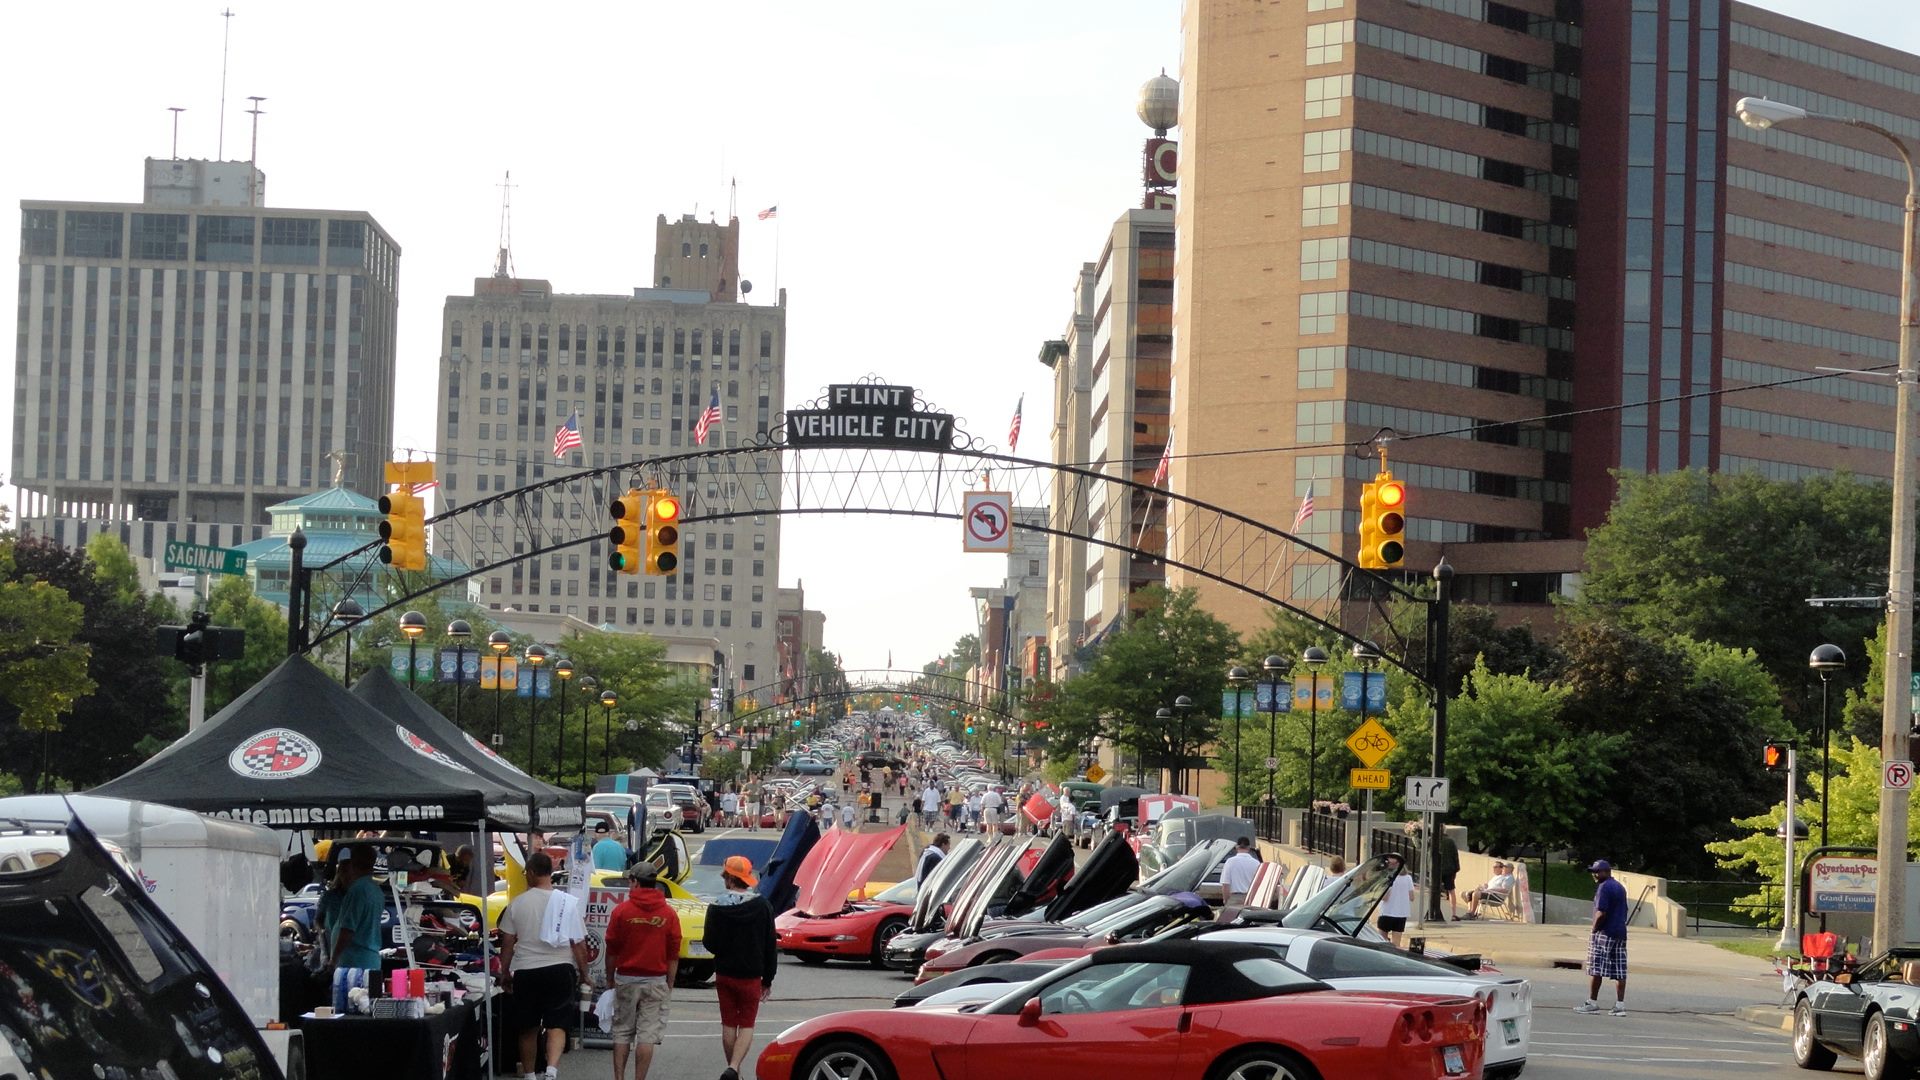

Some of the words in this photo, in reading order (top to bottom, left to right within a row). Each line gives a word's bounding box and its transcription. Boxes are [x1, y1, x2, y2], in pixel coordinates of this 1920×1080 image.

[835, 387, 904, 406] FLINT
[793, 415, 885, 437] VEHICLE
[894, 416, 946, 441] CITY
[167, 543, 226, 570] SAGINAW
[234, 557, 245, 569] ST
[1356, 774, 1385, 784] AHEAD
[1427, 800, 1446, 808] ONLY
[1861, 864, 1878, 878] Par
[1819, 894, 1843, 902] Grand
